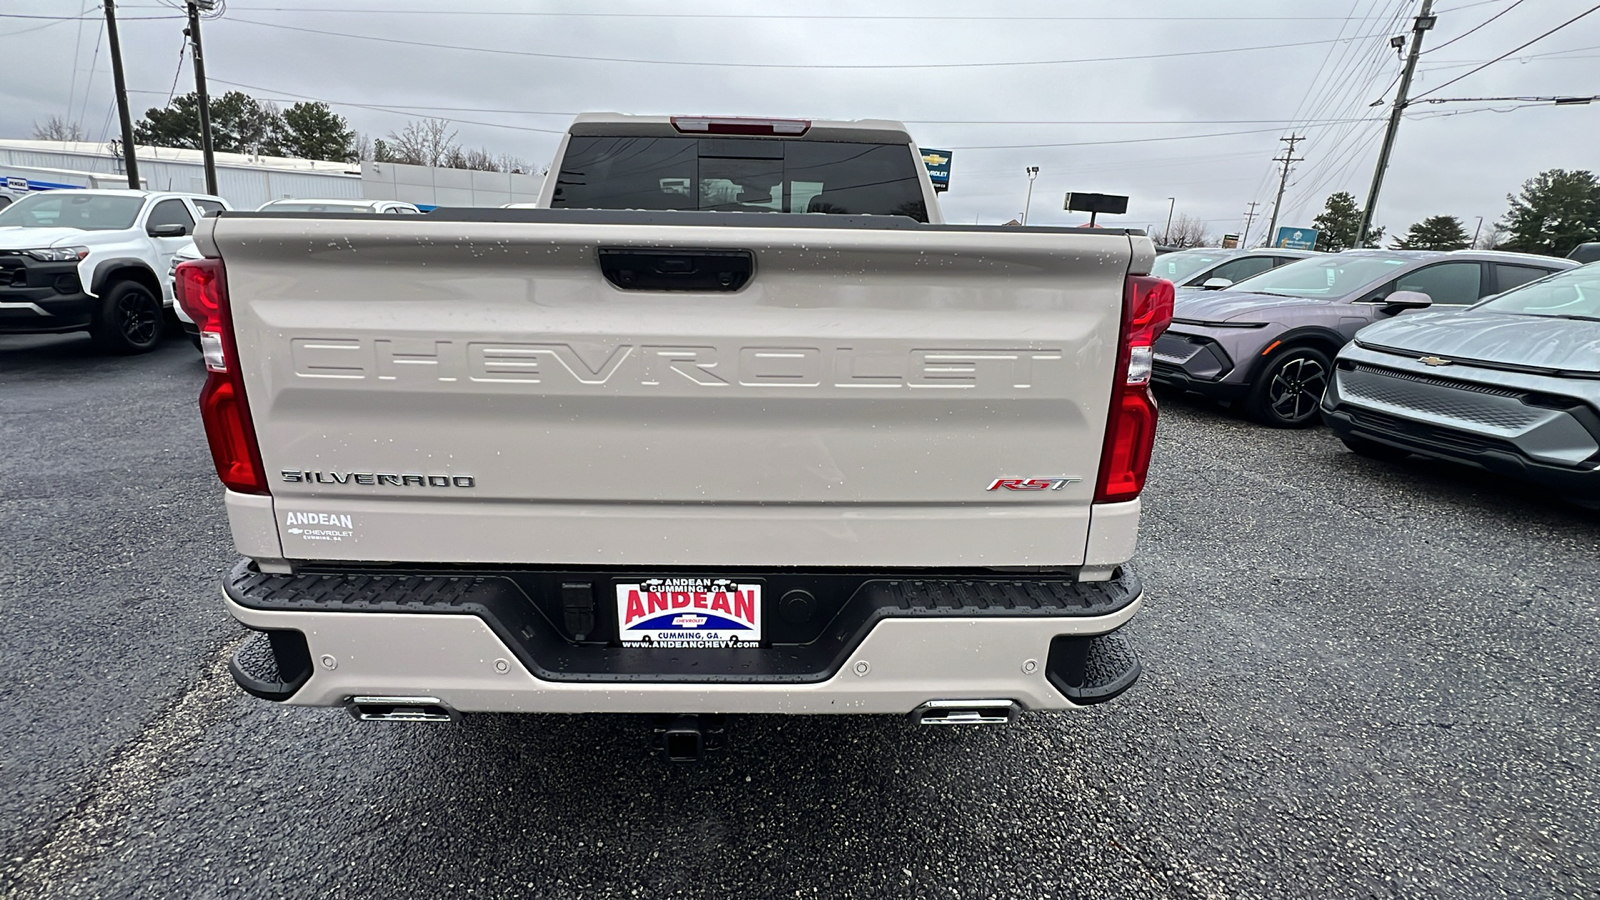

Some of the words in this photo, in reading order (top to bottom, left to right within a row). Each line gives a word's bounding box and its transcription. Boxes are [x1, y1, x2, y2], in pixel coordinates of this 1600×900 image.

[290, 337, 1062, 388] CHEVROLET
[281, 470, 475, 487] SILVERADO
[986, 477, 1082, 491] RST
[286, 511, 353, 529] ANDEAN
[649, 585, 708, 593] CUMMING,
[664, 578, 711, 586] ANDEAN
[624, 590, 755, 625] ANDEAN
[657, 632, 704, 640] CUMMING,
[622, 640, 759, 648] www.ANDEANCHEVY.com
